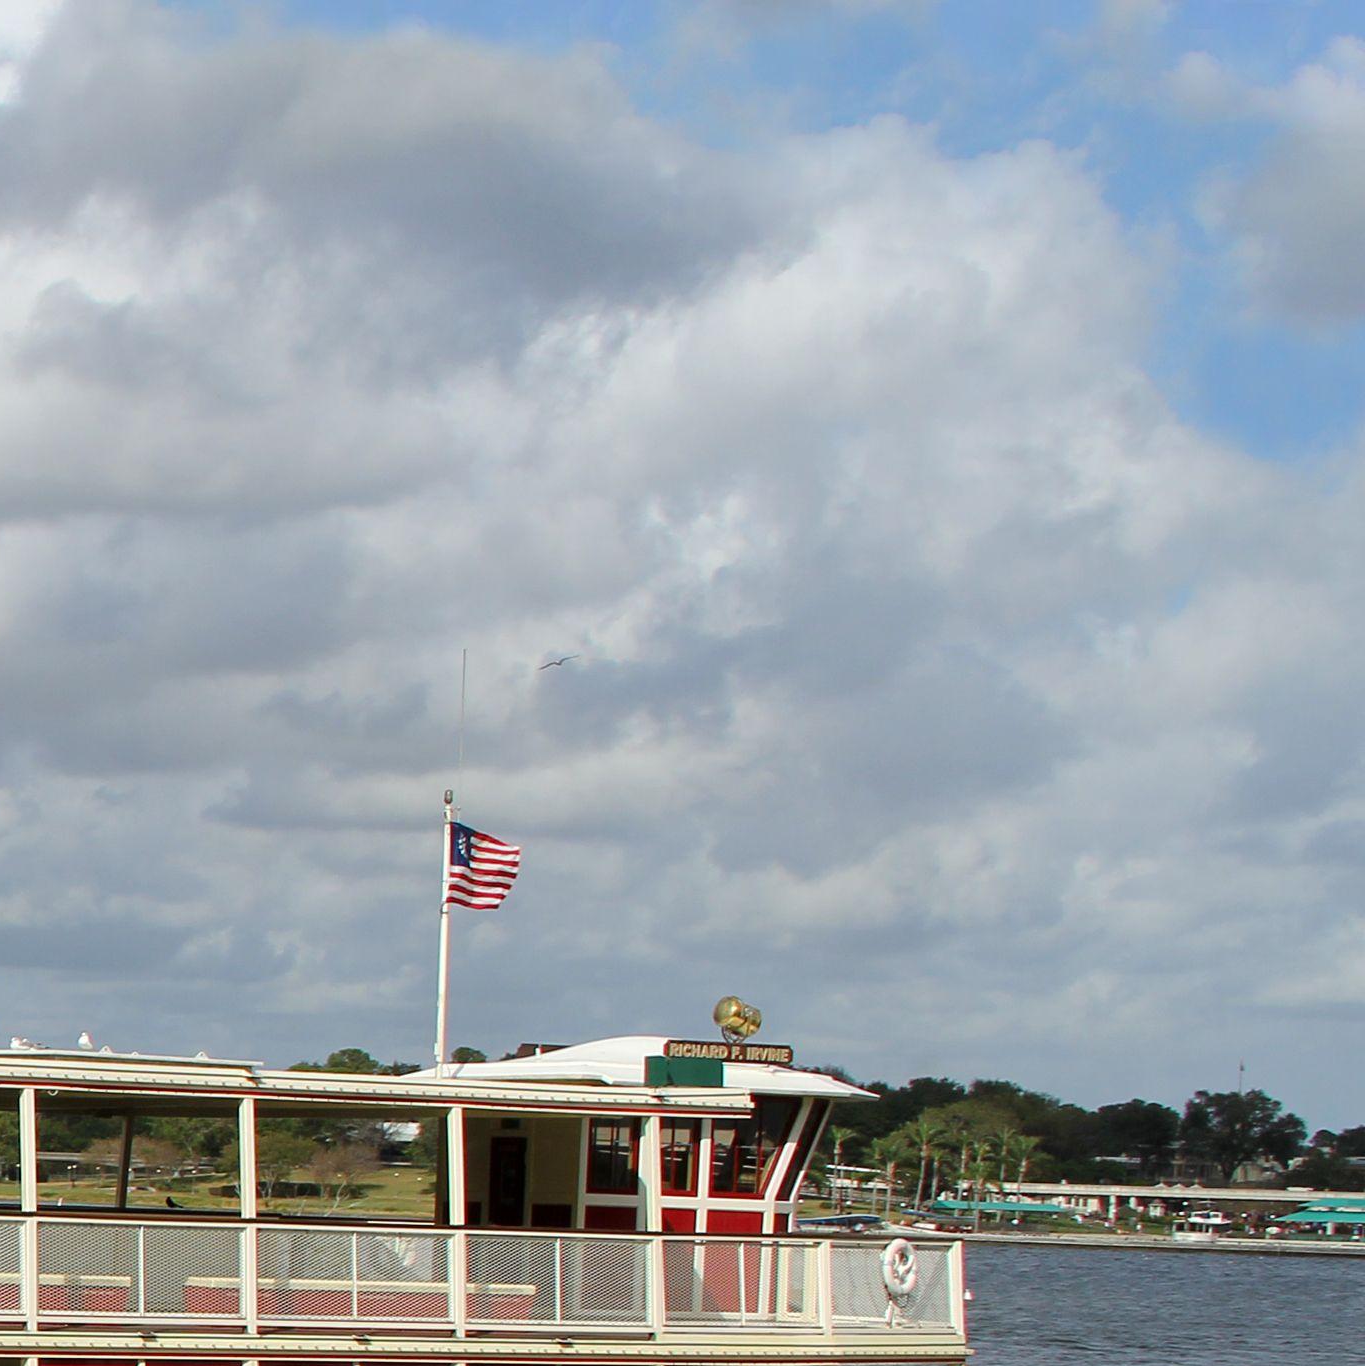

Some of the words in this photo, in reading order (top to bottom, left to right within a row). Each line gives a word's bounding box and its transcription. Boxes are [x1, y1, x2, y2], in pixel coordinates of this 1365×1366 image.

[668, 1042, 728, 1060] RICHARD
[731, 1047, 743, 1060] F.
[746, 1046, 790, 1063] IRVINE
